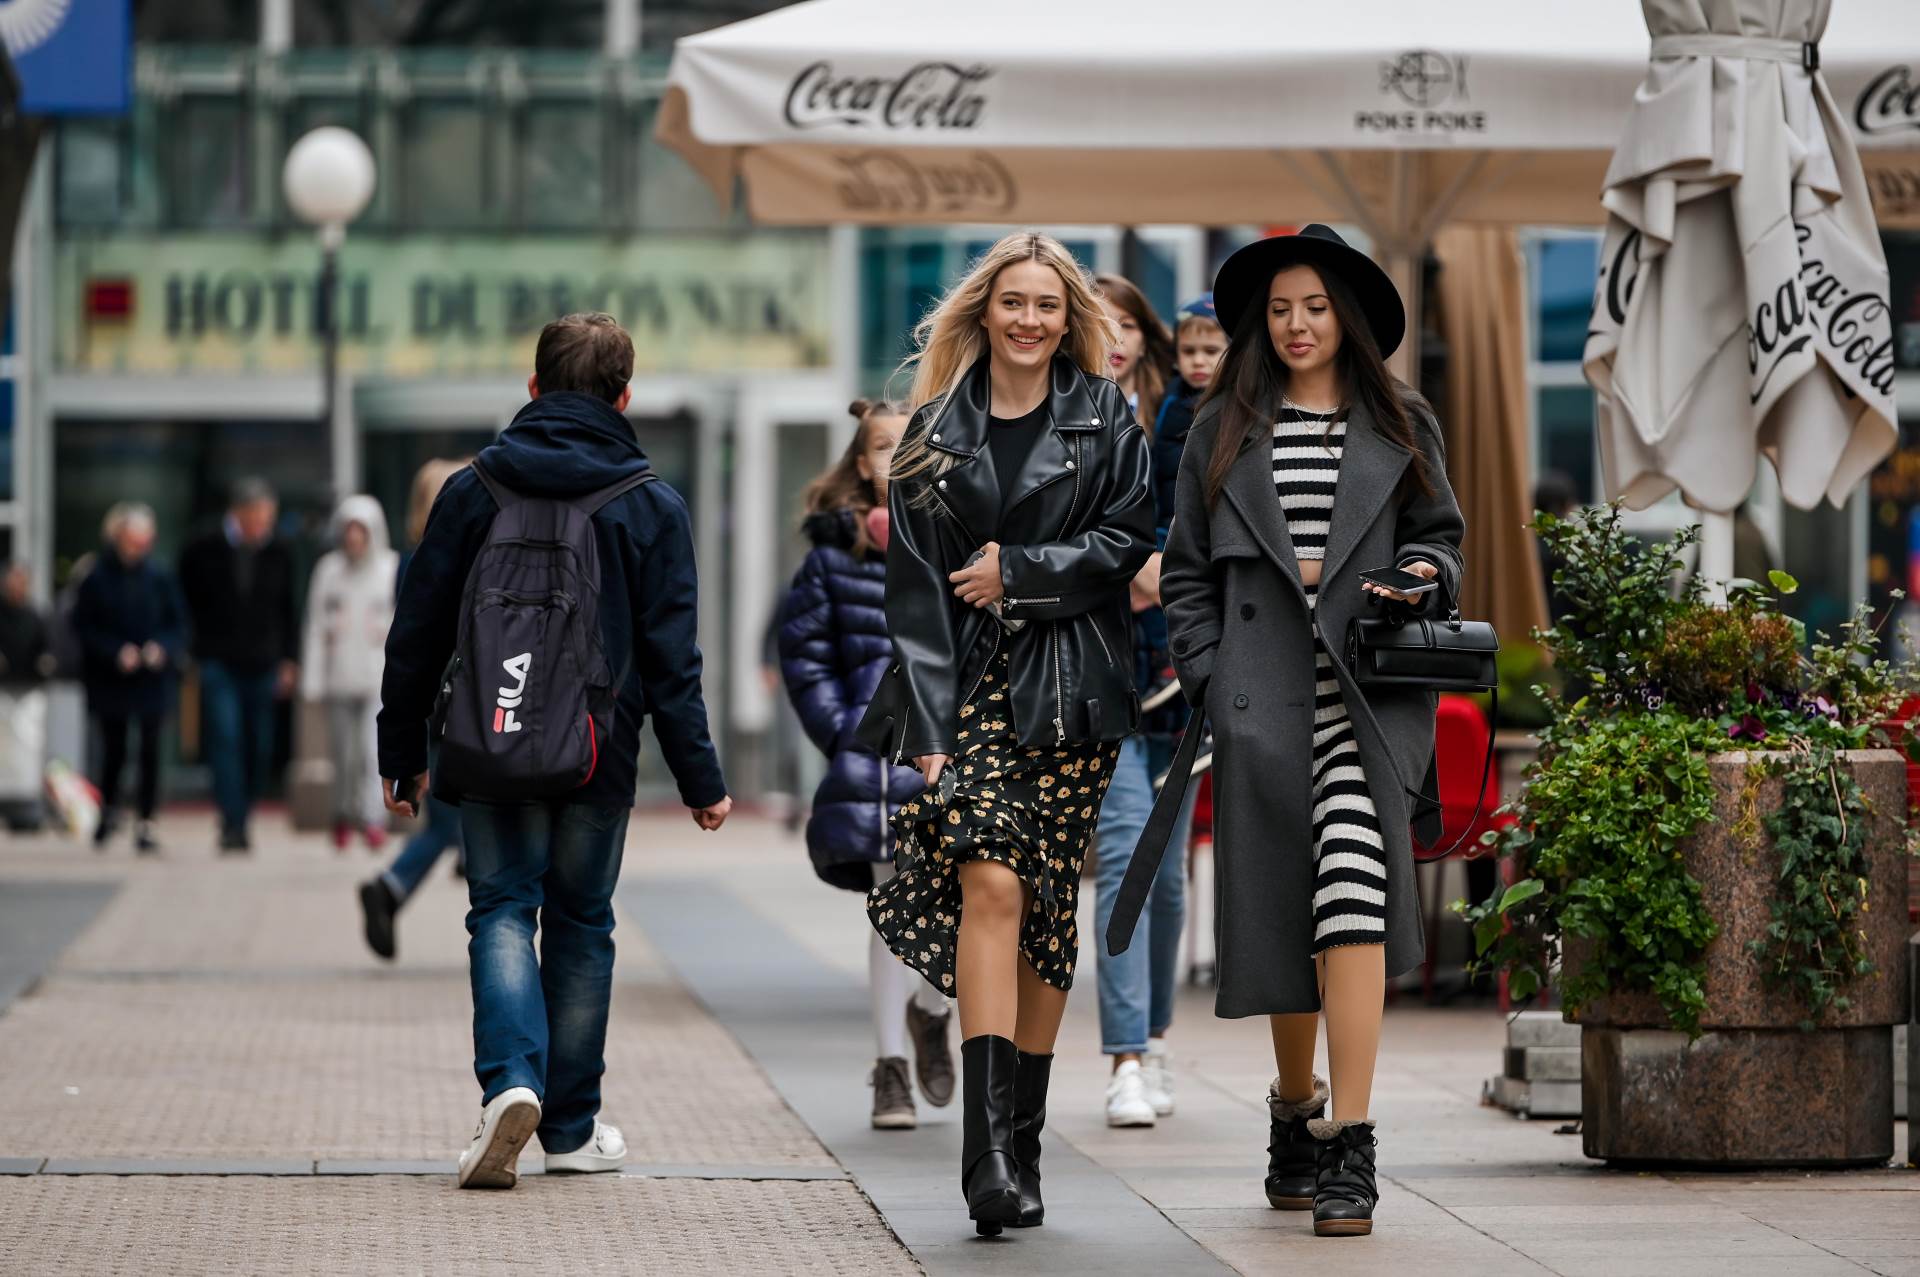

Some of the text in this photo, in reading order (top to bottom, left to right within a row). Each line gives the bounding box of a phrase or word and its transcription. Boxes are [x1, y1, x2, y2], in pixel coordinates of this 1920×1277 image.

[1354, 111, 1486, 133] POKE POKE
[493, 652, 532, 733] FILA
